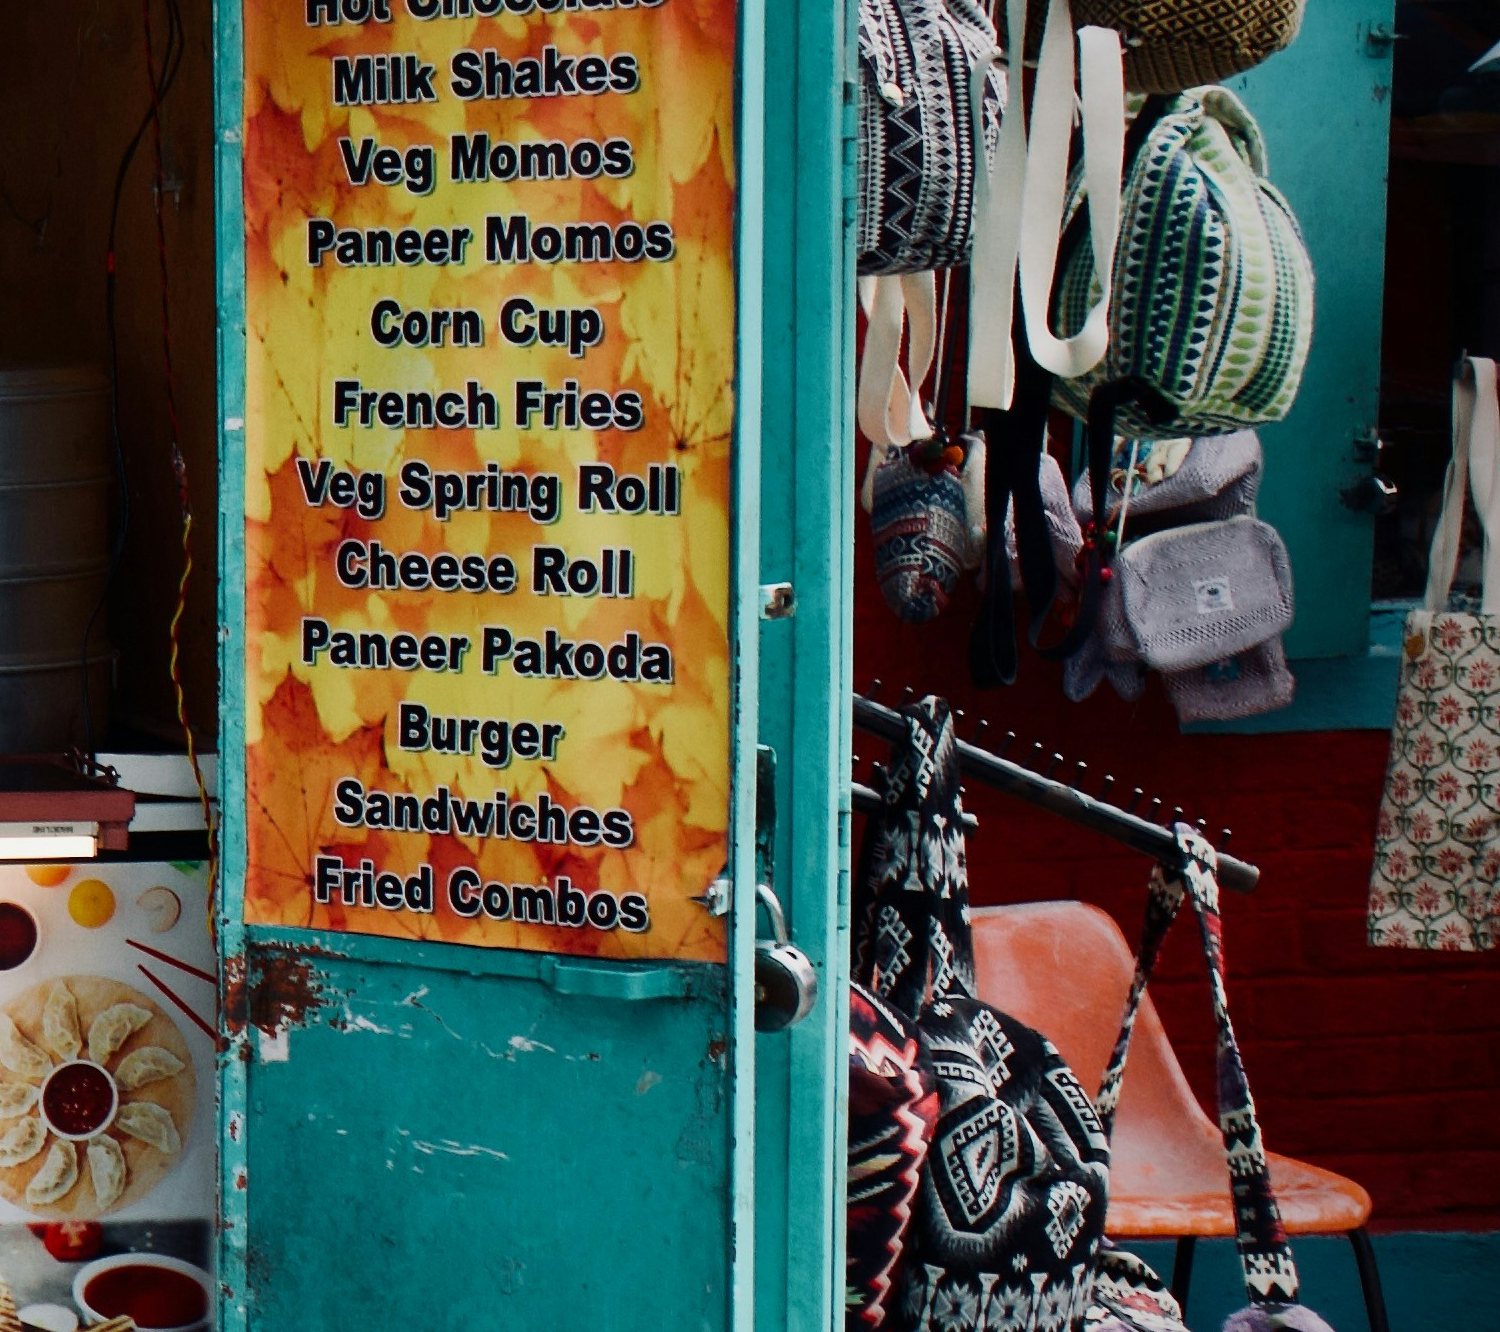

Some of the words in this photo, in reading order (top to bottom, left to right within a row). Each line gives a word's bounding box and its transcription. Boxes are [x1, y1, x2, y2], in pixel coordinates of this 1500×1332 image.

[334, 56, 436, 106] Milk
[451, 51, 639, 97] Shakes
[339, 138, 436, 195] Veg
[451, 134, 634, 183] Momos
[308, 220, 470, 267] Paneer
[486, 215, 675, 265] Momos
[371, 299, 480, 348] Corn
[500, 299, 604, 355] Cup
[334, 380, 496, 429] French
[516, 381, 645, 432] Fries
[297, 460, 387, 521] Veg
[399, 462, 558, 522] Spring
[578, 465, 677, 515] Roll
[337, 541, 517, 596] Cheese
[533, 547, 631, 596] Roll
[302, 619, 468, 671] Paneer
[482, 627, 674, 681] Pakoda
[399, 703, 563, 769] Burger
[334, 780, 635, 848] Sandwiches
[316, 857, 436, 914] Fried
[449, 869, 649, 933] Combos
